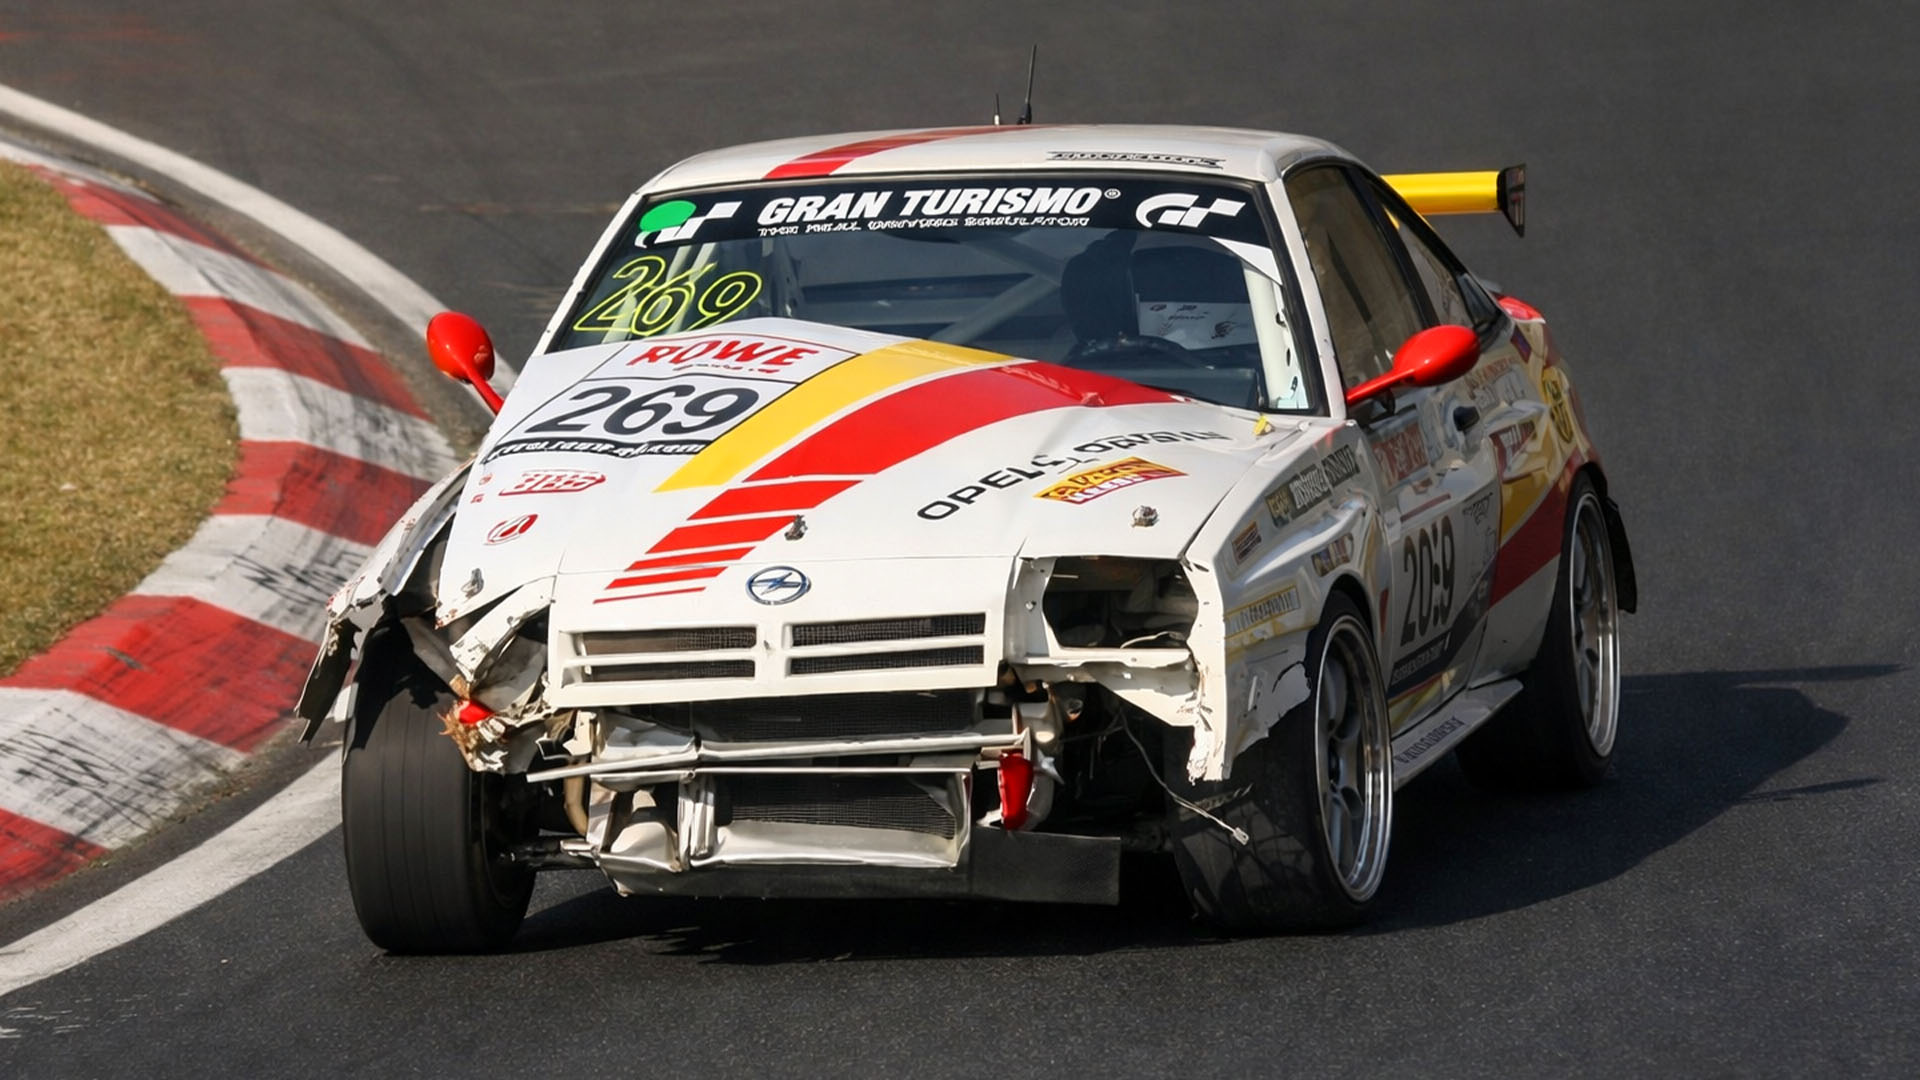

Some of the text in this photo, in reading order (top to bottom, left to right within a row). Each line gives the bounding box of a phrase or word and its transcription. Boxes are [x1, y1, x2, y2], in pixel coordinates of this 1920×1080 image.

[757, 190, 894, 225] GRAN
[573, 256, 762, 336] 269
[626, 340, 820, 367] ROWE
[525, 383, 759, 437] 269
